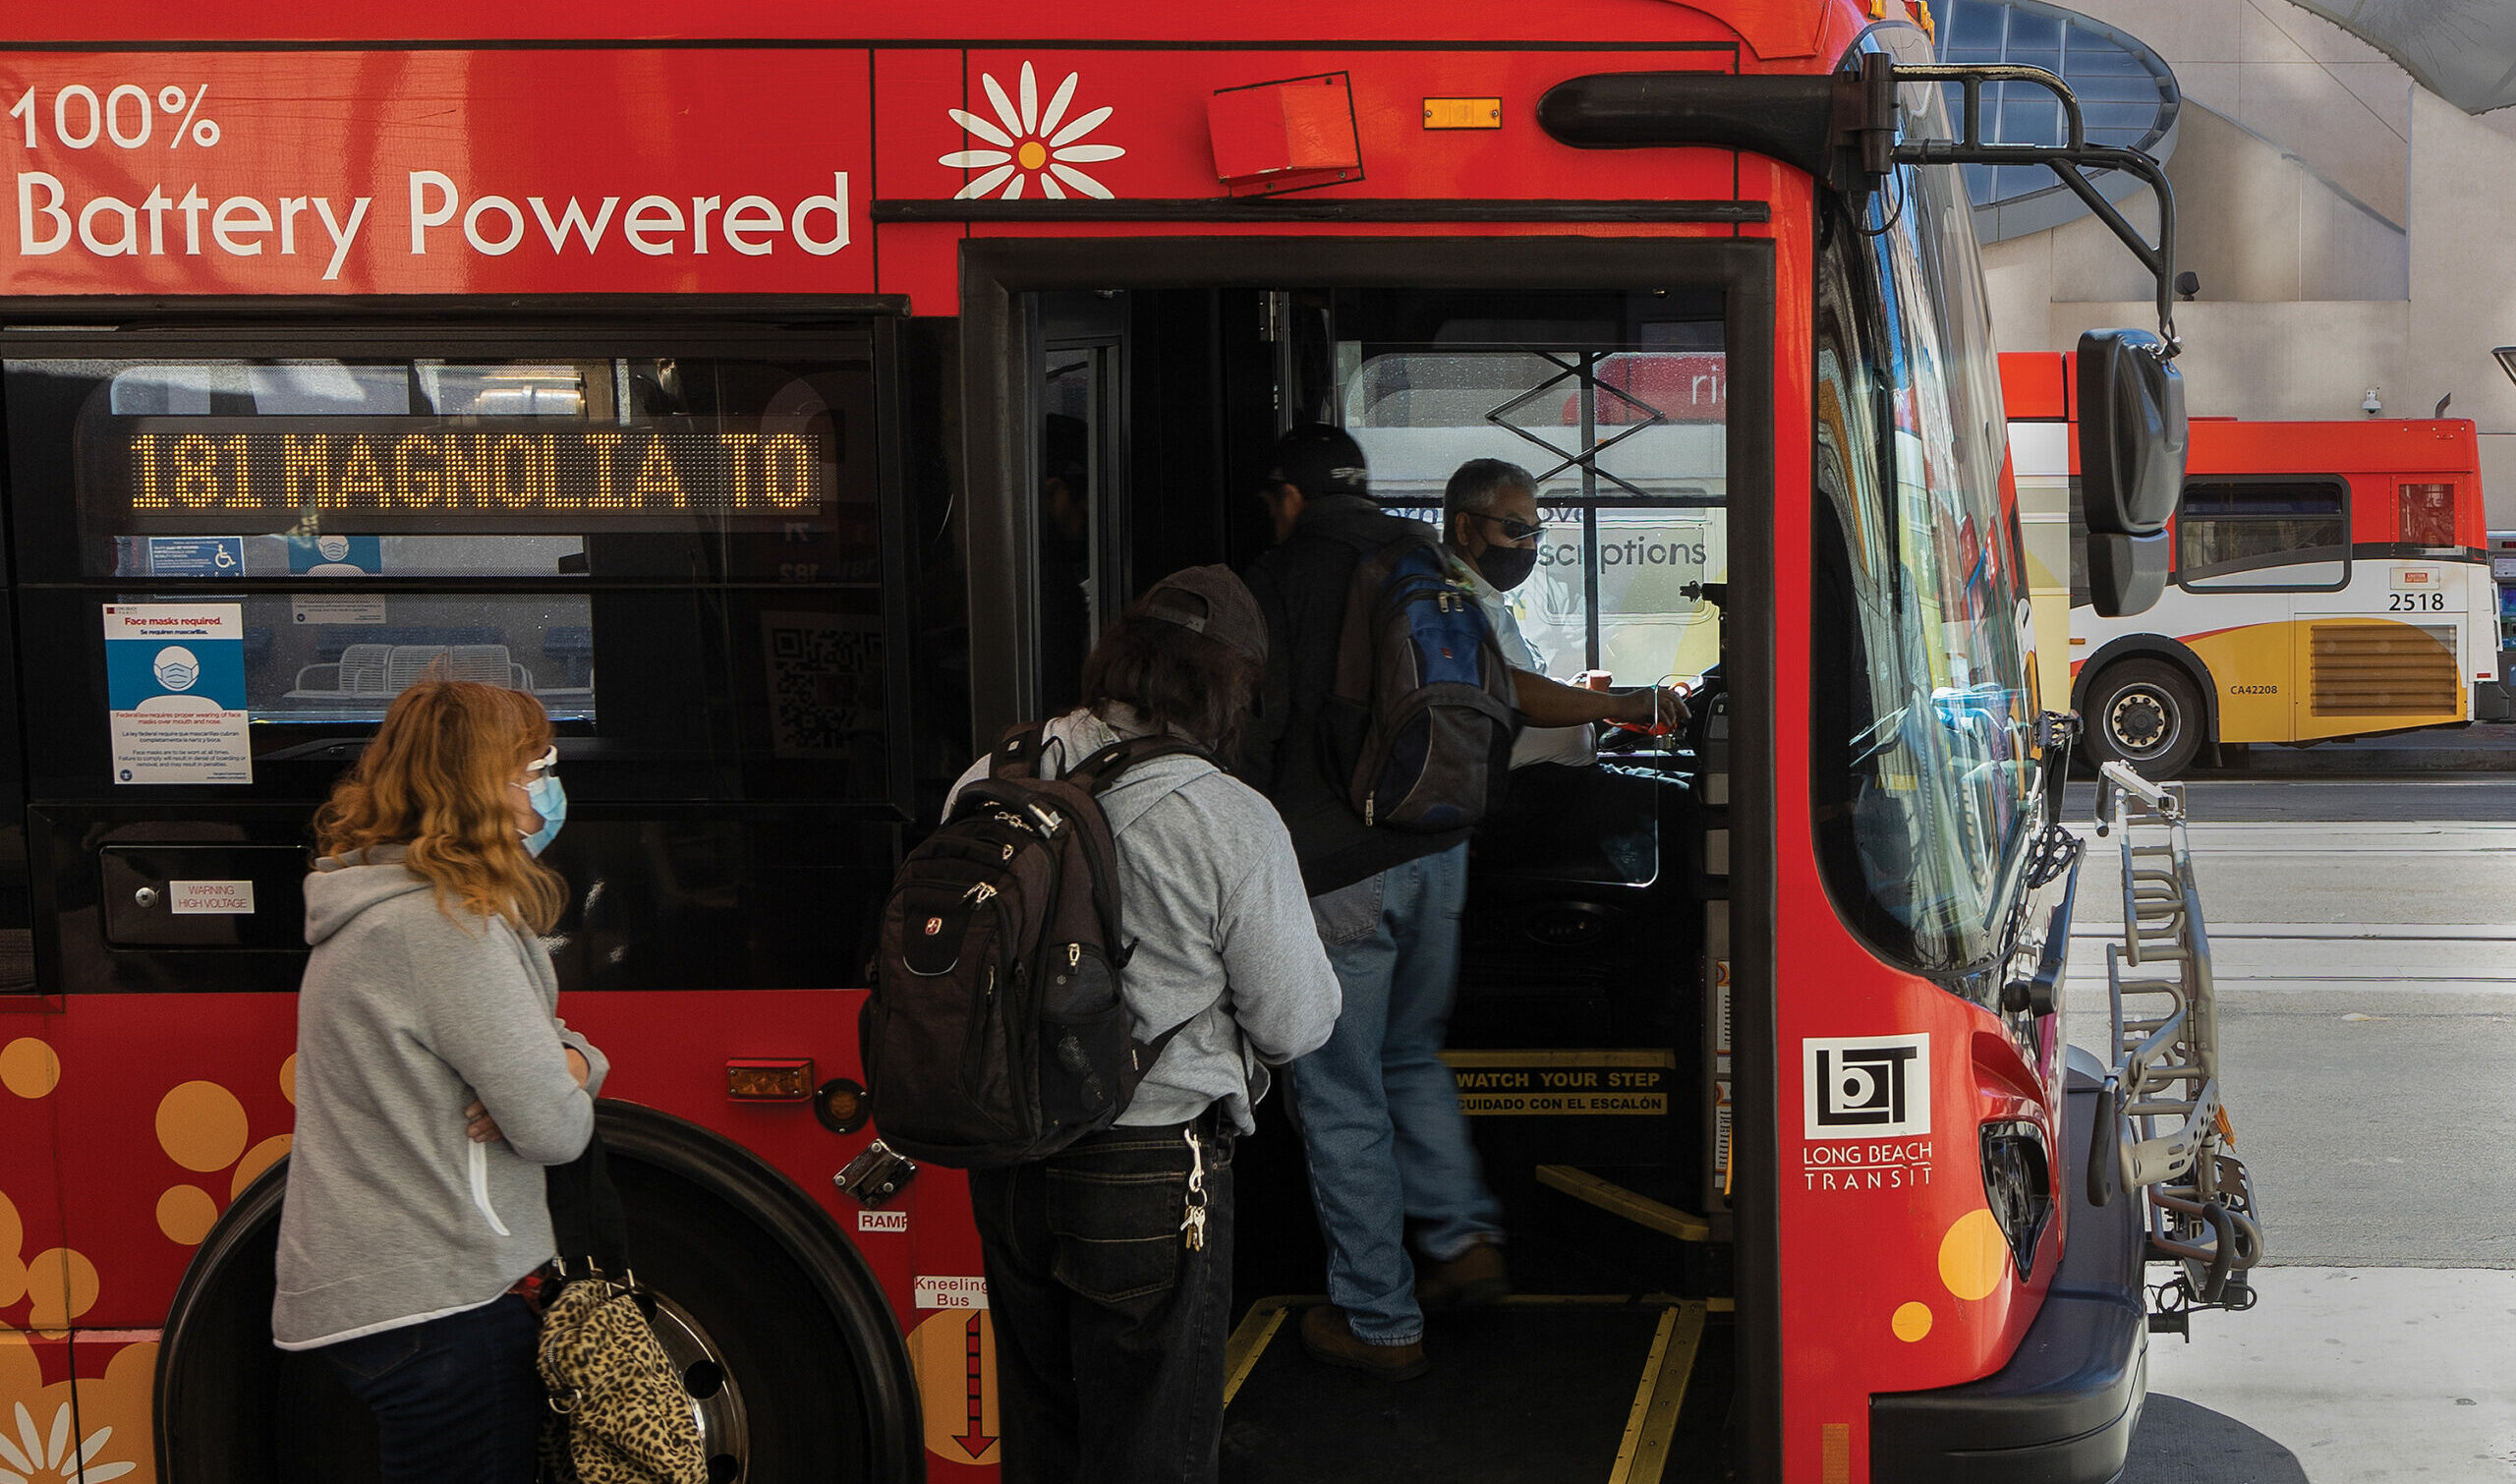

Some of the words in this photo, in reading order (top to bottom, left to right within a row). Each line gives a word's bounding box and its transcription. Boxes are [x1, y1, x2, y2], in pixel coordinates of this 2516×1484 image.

[9, 83, 221, 149] 100%
[17, 170, 372, 281] Battery
[408, 170, 851, 257] Powered
[1691, 364, 1727, 405] ri
[131, 432, 263, 509] 181
[284, 432, 687, 509] MAGNOLIA
[721, 432, 810, 509] TO
[1537, 536, 1707, 575] scptions
[2388, 593, 2444, 611] 2518
[124, 617, 147, 626] Face
[148, 617, 179, 626] masks
[181, 616, 223, 627] required.
[2230, 685, 2278, 695] CA42208
[188, 885, 235, 895] WARNING
[178, 898, 203, 908] HIGH
[204, 898, 247, 908] VOLTAGE
[1456, 1072, 1529, 1088] WATCH
[1540, 1072, 1599, 1088] YOUR
[1607, 1072, 1660, 1087] STEP
[1529, 1098, 1563, 1111] CON
[1567, 1098, 1586, 1110] EL
[1590, 1096, 1662, 1110] ESCALÓN
[1803, 1146, 1861, 1165] LONG
[1868, 1141, 1932, 1164] BEACH
[1803, 1167, 1932, 1191] TRANSIT
[937, 1293, 970, 1307] Bus
